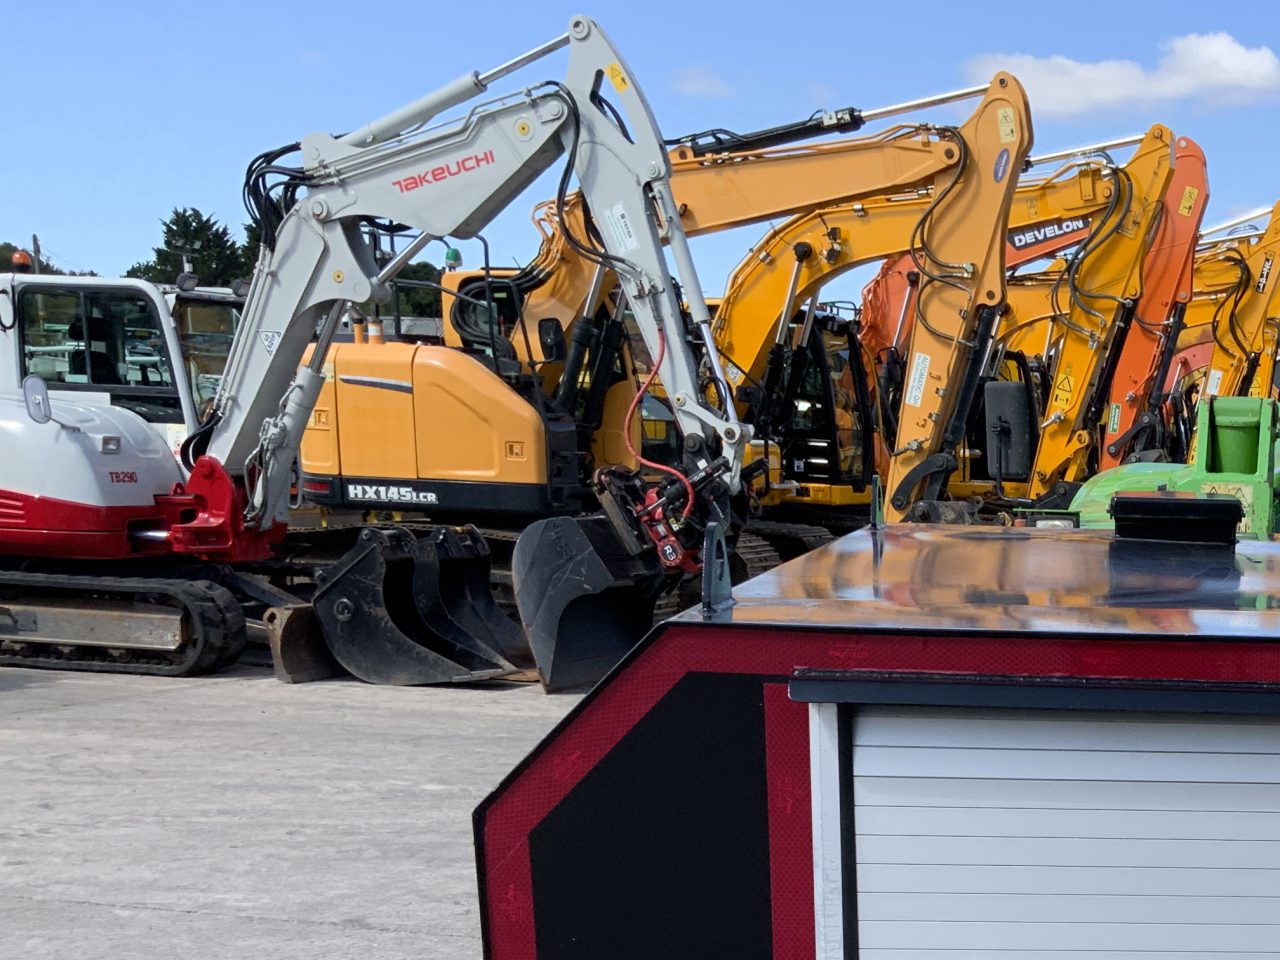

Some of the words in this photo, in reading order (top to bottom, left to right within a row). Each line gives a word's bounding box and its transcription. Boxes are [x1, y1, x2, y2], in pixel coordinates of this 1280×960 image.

[392, 150, 496, 193] TAKEUCHI
[1013, 220, 1084, 247] DEVELON
[109, 471, 138, 484] TB290
